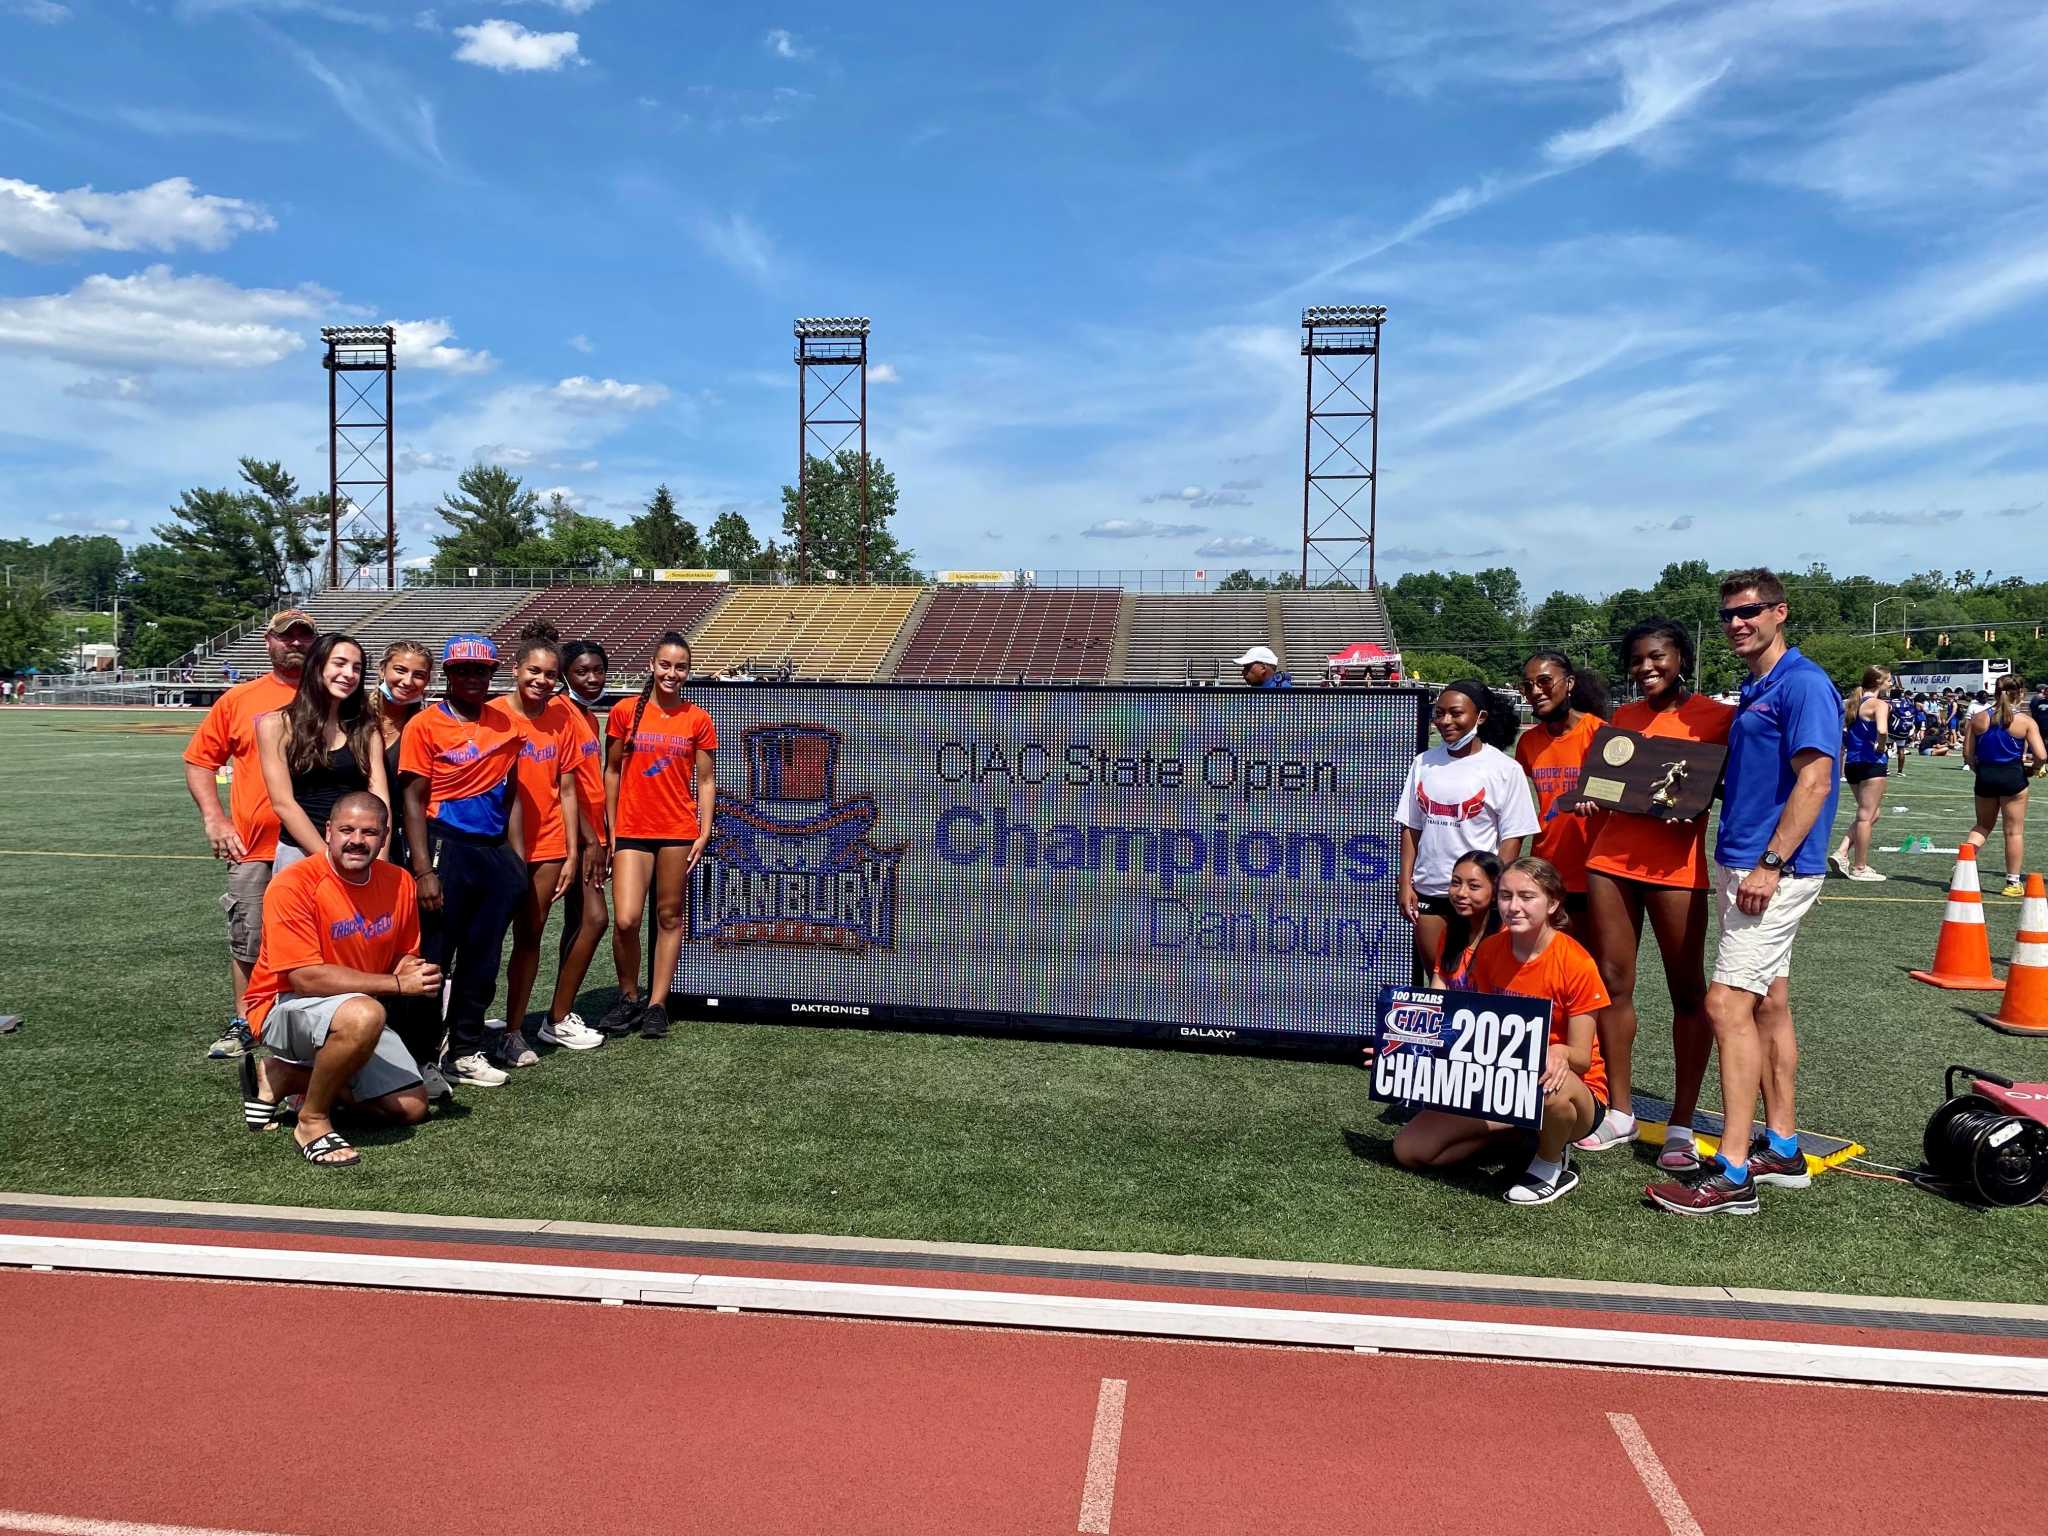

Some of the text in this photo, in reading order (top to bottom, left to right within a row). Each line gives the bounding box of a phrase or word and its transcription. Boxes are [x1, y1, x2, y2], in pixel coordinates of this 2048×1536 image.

[449, 642, 492, 659] NEW YORK
[1910, 675, 1951, 684] KING GRAY
[935, 741, 1337, 803] CIAC State Open
[935, 804, 1389, 892] Champions
[695, 856, 893, 940] DANBURY
[1149, 897, 1388, 971] Danbury
[791, 1003, 870, 1016] DAKTRONICS
[1392, 990, 1444, 1005] 100 YEARS
[1394, 1009, 1445, 1034] CIAC
[1449, 1008, 1544, 1072] 2021
[1375, 1053, 1539, 1120] CHAMPION
